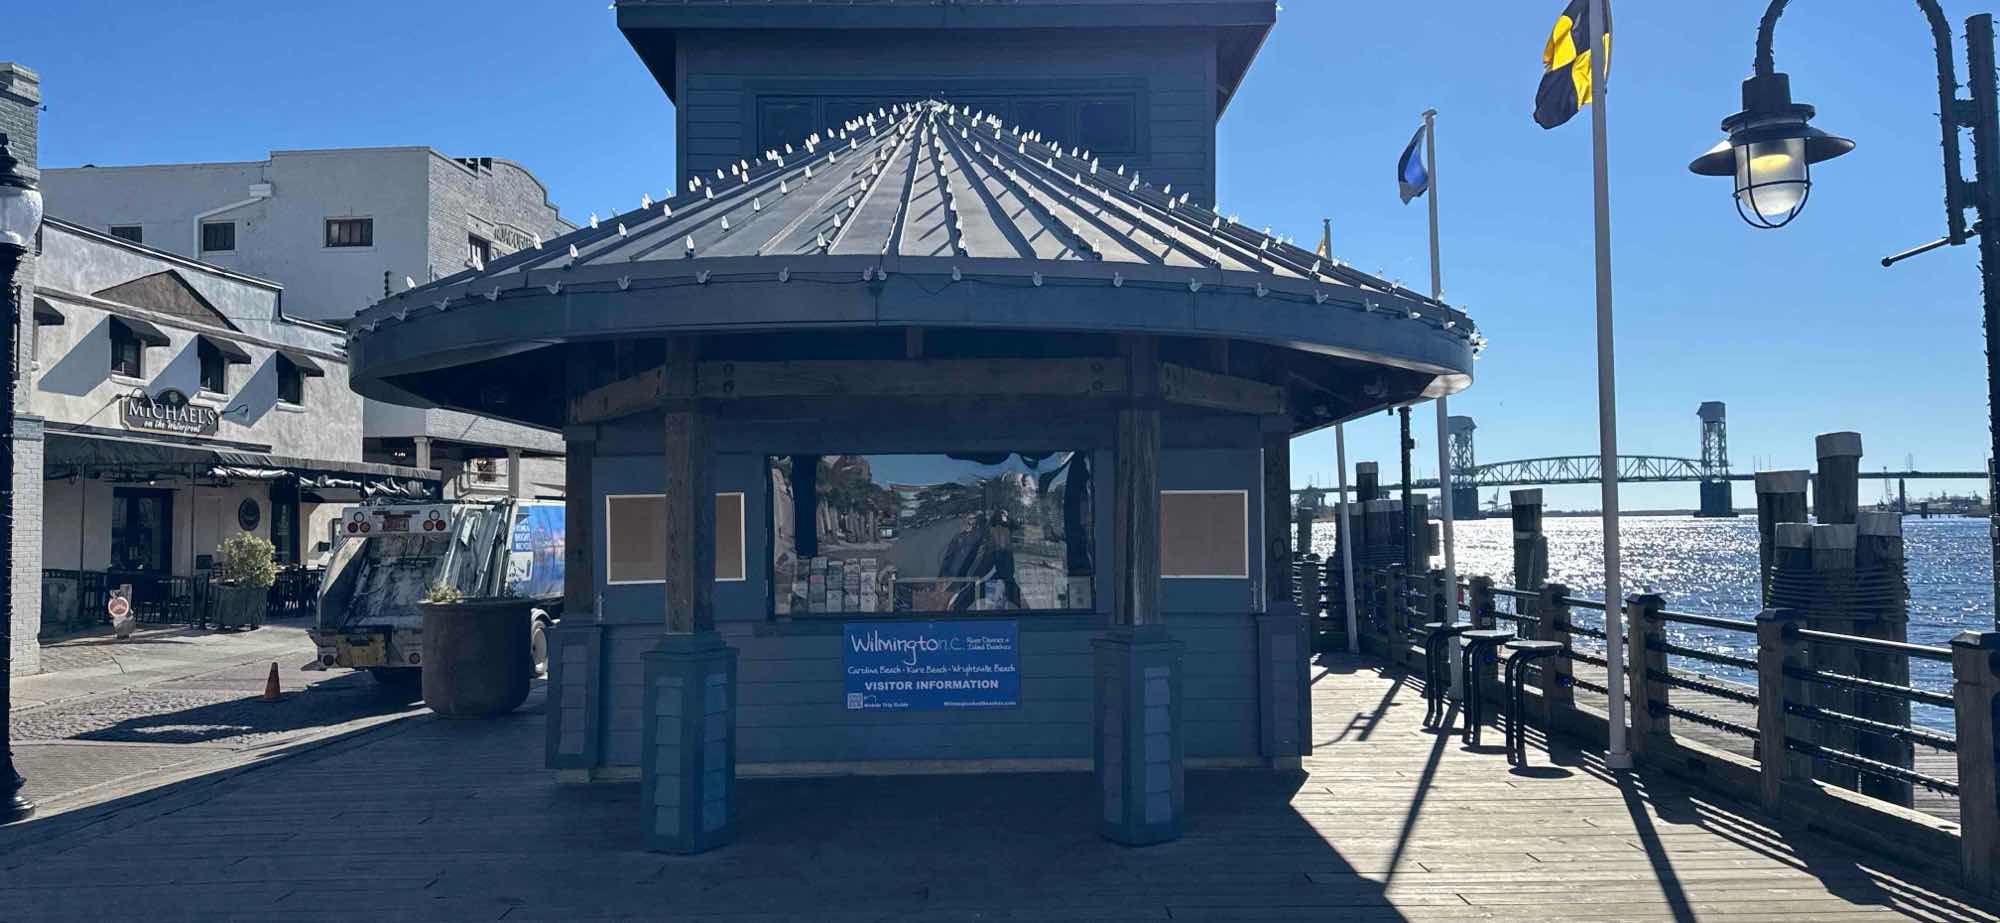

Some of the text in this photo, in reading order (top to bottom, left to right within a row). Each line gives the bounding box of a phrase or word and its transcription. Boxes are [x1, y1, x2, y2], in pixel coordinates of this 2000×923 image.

[129, 401, 215, 425] MICHAEL'S
[847, 665, 879, 674] Carolina
[880, 665, 901, 673] Beach
[906, 665, 925, 673] Kure
[927, 665, 947, 673] Beach
[994, 664, 1016, 673] Beach
[864, 679, 999, 691] VISITOR INFORMATION
